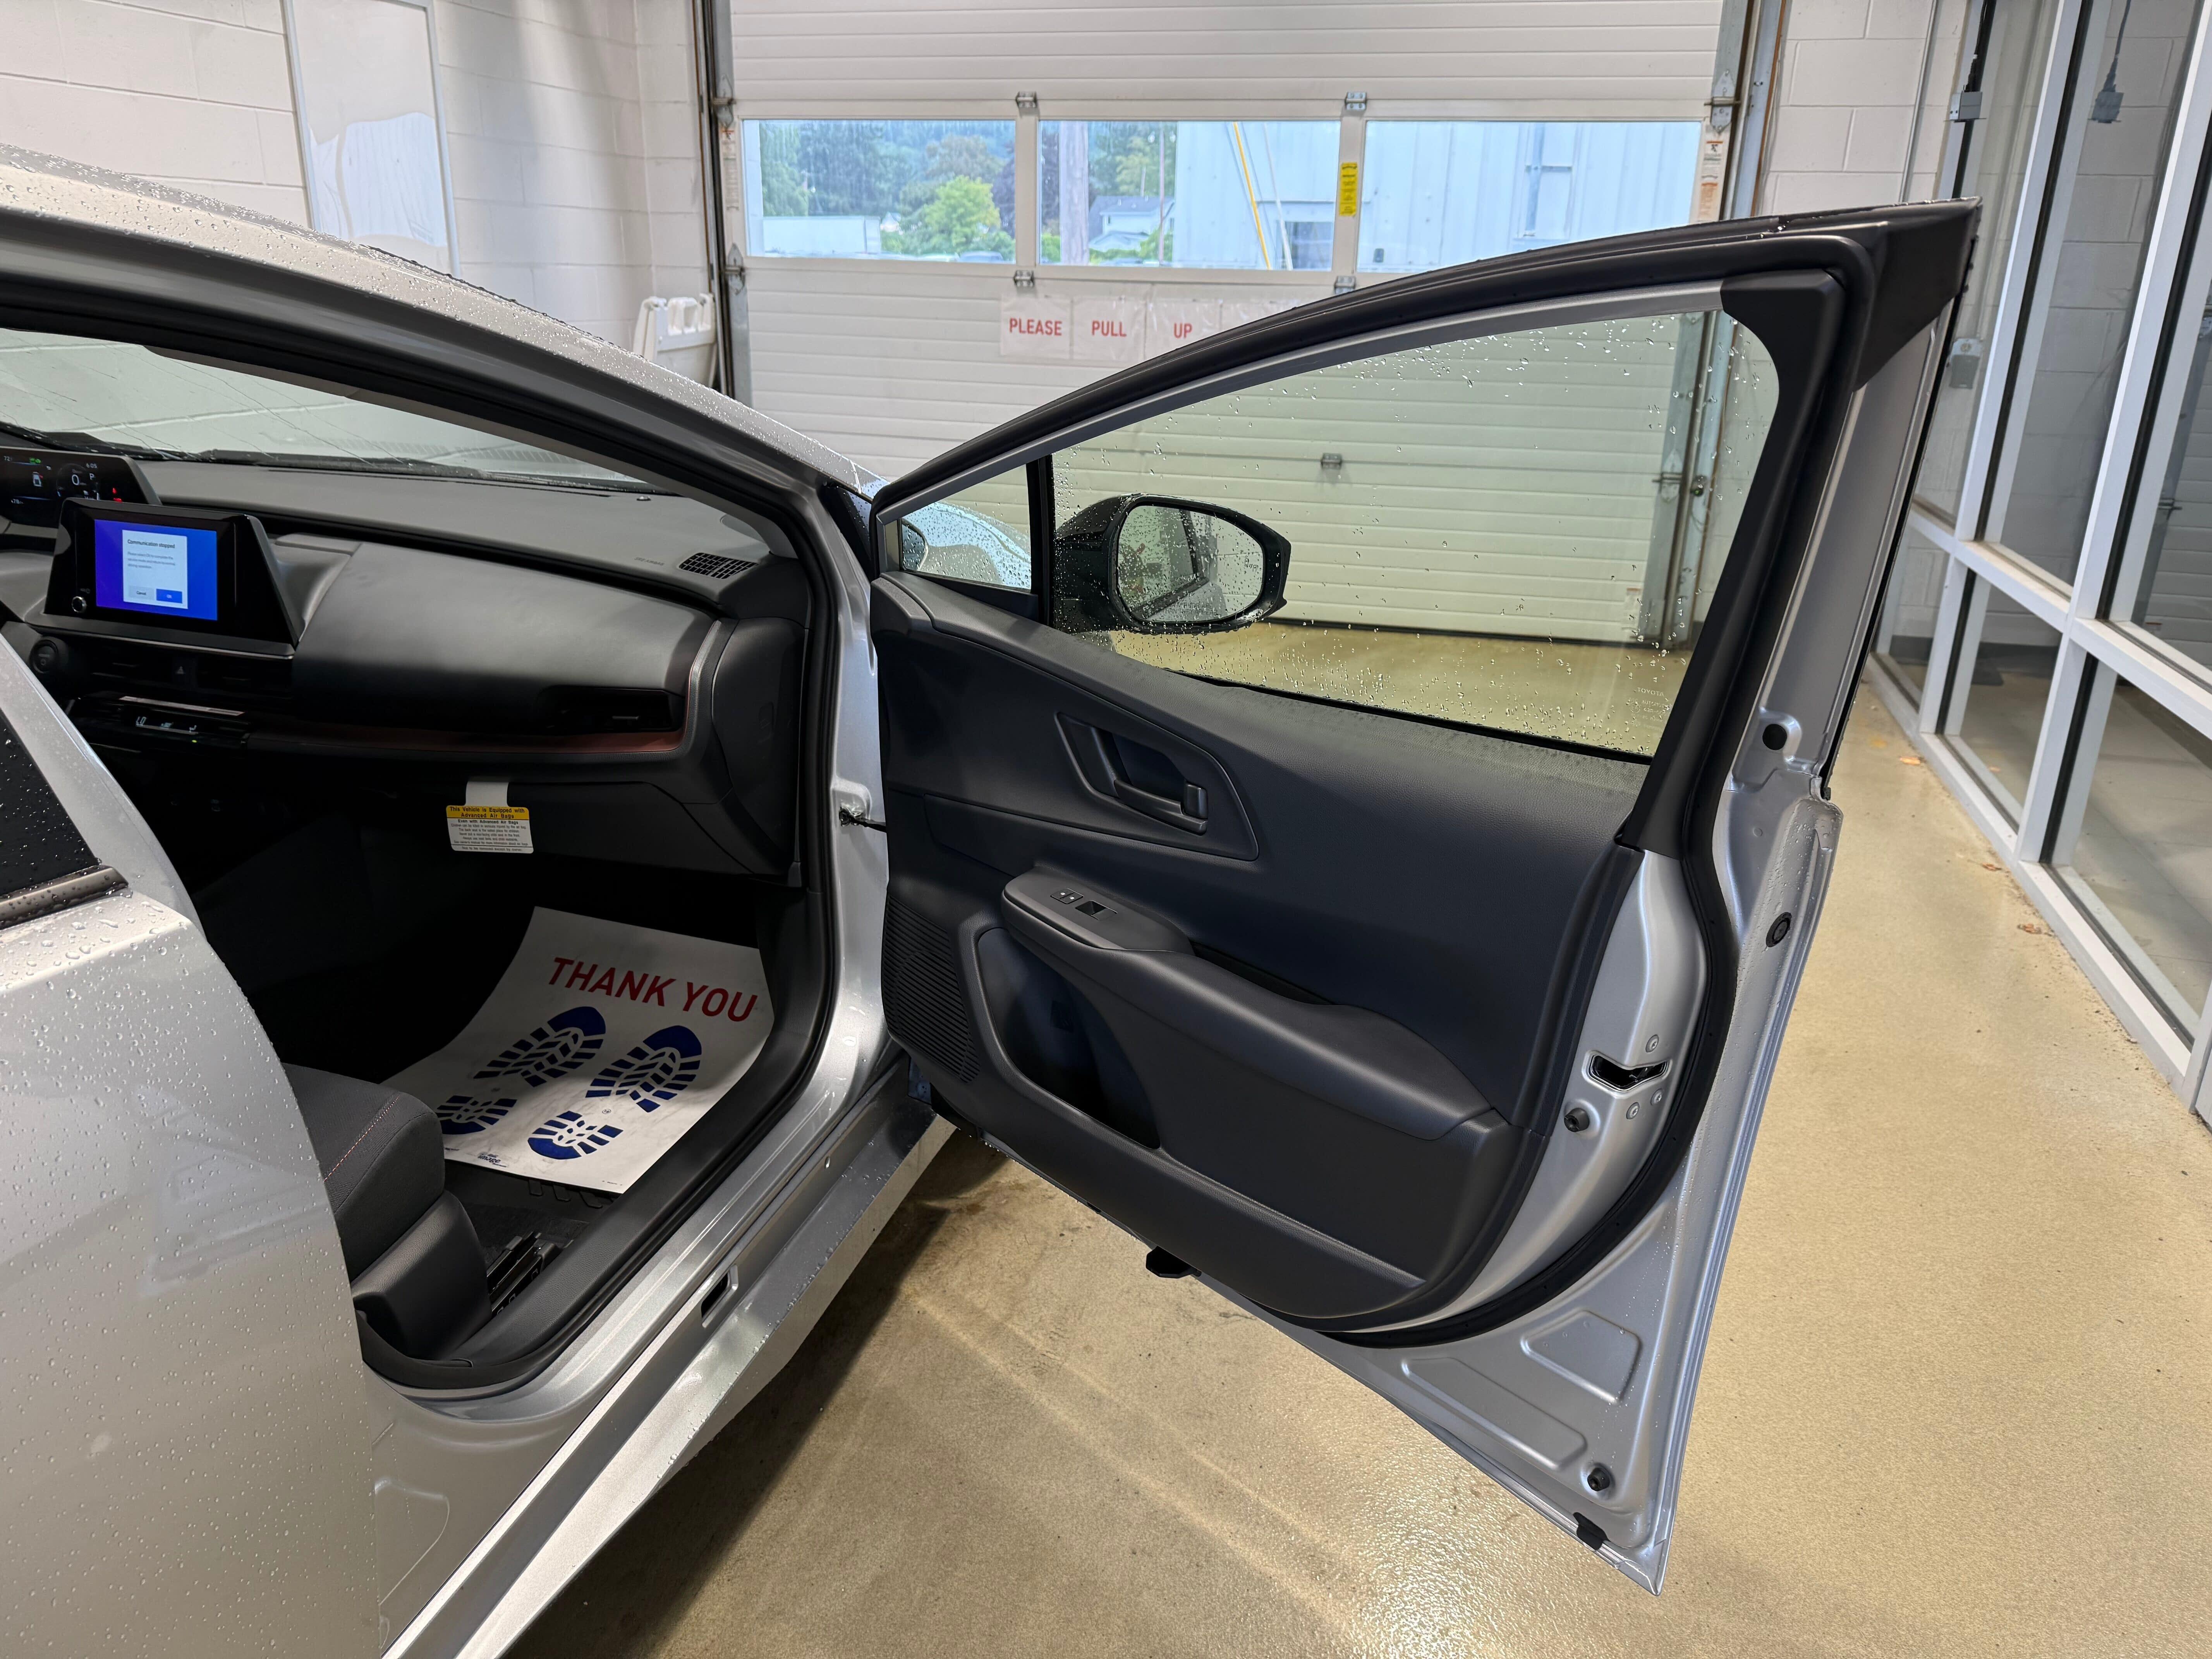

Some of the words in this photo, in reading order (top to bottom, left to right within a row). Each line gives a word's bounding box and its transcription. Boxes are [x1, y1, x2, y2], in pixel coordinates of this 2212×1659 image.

[1009, 318, 1062, 336] PLEASE
[1091, 320, 1127, 337] PULL
[1174, 323, 1192, 338] UP
[72, 474, 79, 485] 0
[1637, 687, 1664, 697] TOYOTA
[549, 957, 676, 1007] THANK
[683, 982, 758, 1022] YOU
